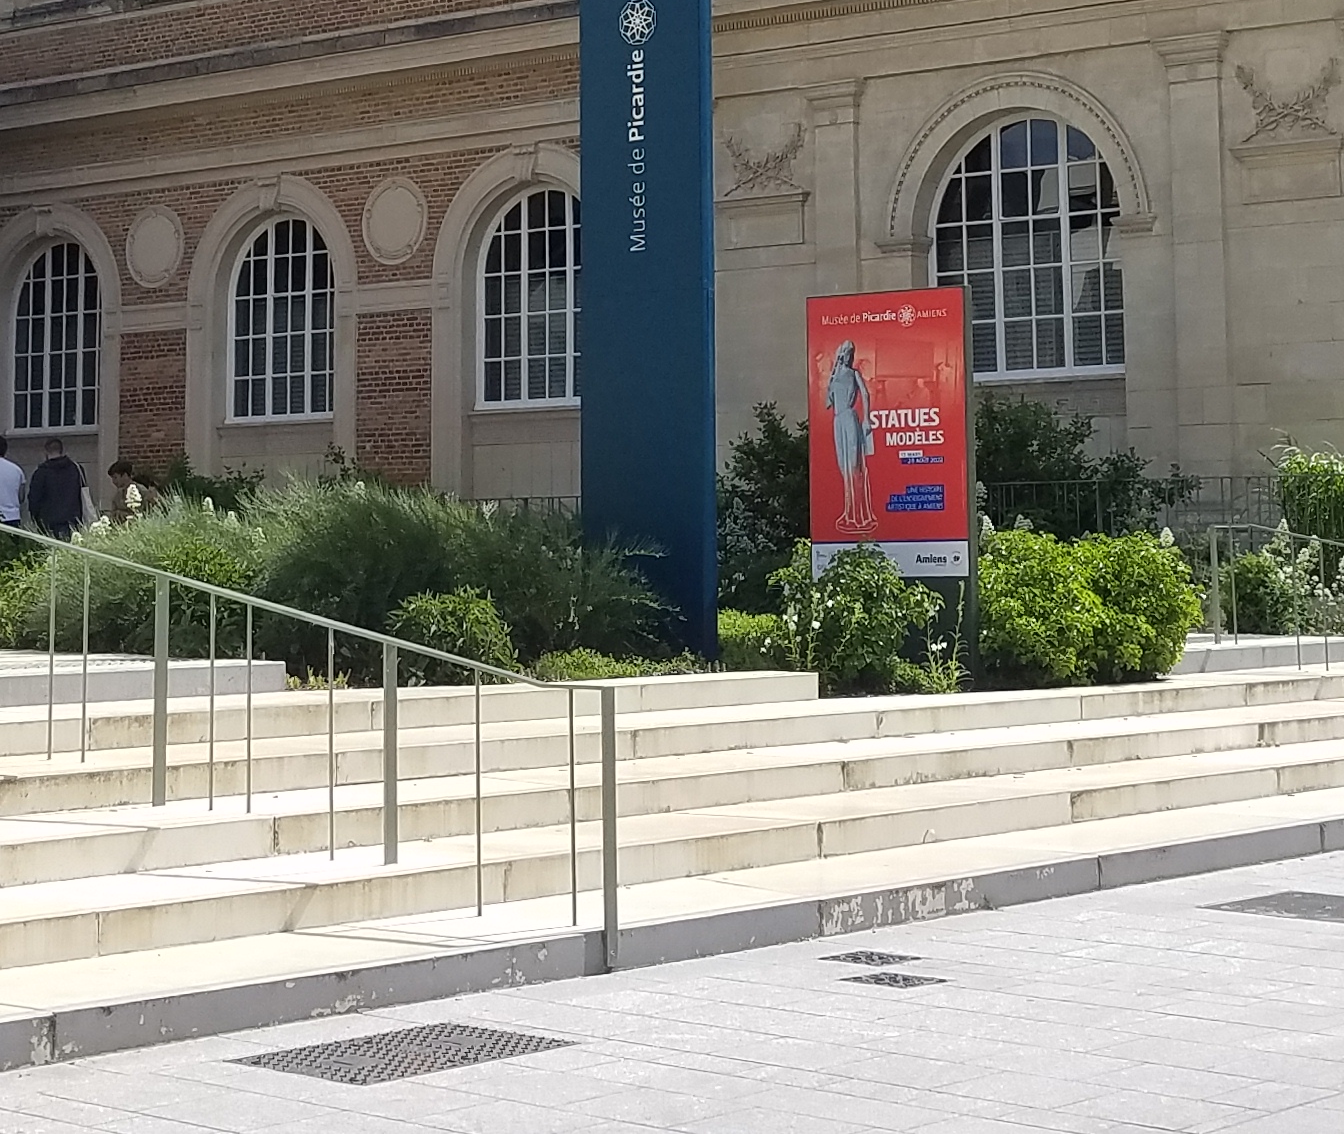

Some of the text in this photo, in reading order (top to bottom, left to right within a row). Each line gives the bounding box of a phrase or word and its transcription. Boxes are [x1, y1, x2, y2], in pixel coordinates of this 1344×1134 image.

[626, 49, 645, 142] Picardie
[627, 148, 645, 175] de
[629, 181, 646, 252] Musée
[821, 308, 947, 325] Musée de Picardie AMIENS
[869, 407, 940, 429] STATUES
[886, 427, 945, 446] MODÈLES
[915, 554, 948, 564] Amiens
